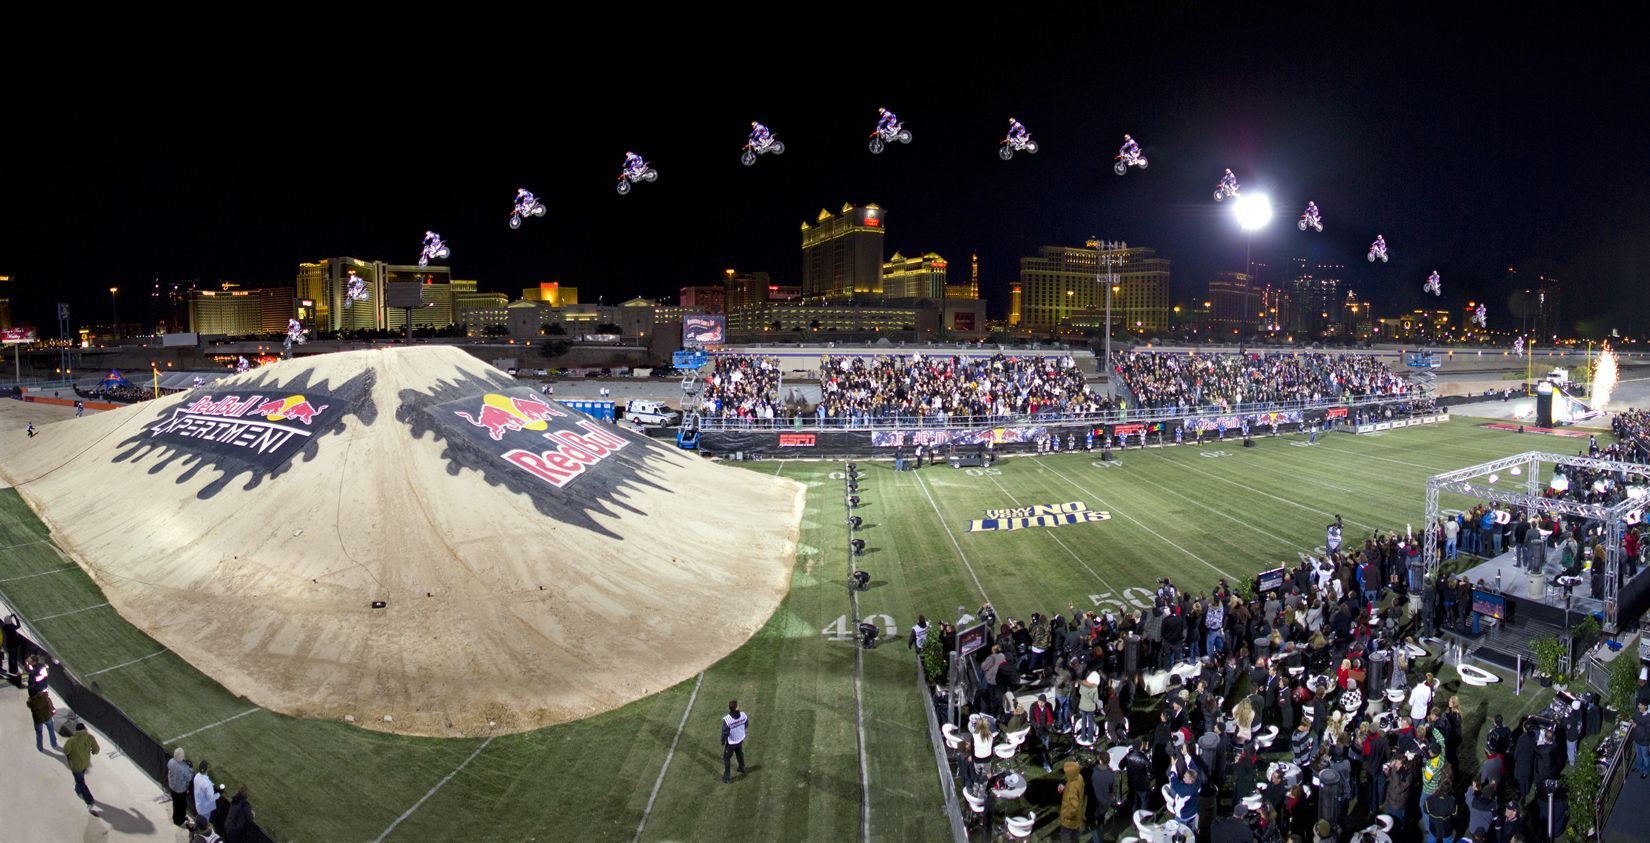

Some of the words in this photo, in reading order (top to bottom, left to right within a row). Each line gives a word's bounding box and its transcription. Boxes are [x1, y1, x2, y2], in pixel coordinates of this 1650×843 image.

[779, 434, 816, 447] ESPN
[1033, 501, 1087, 516] NO
[1088, 587, 1158, 615] 50
[821, 614, 898, 641] 40
